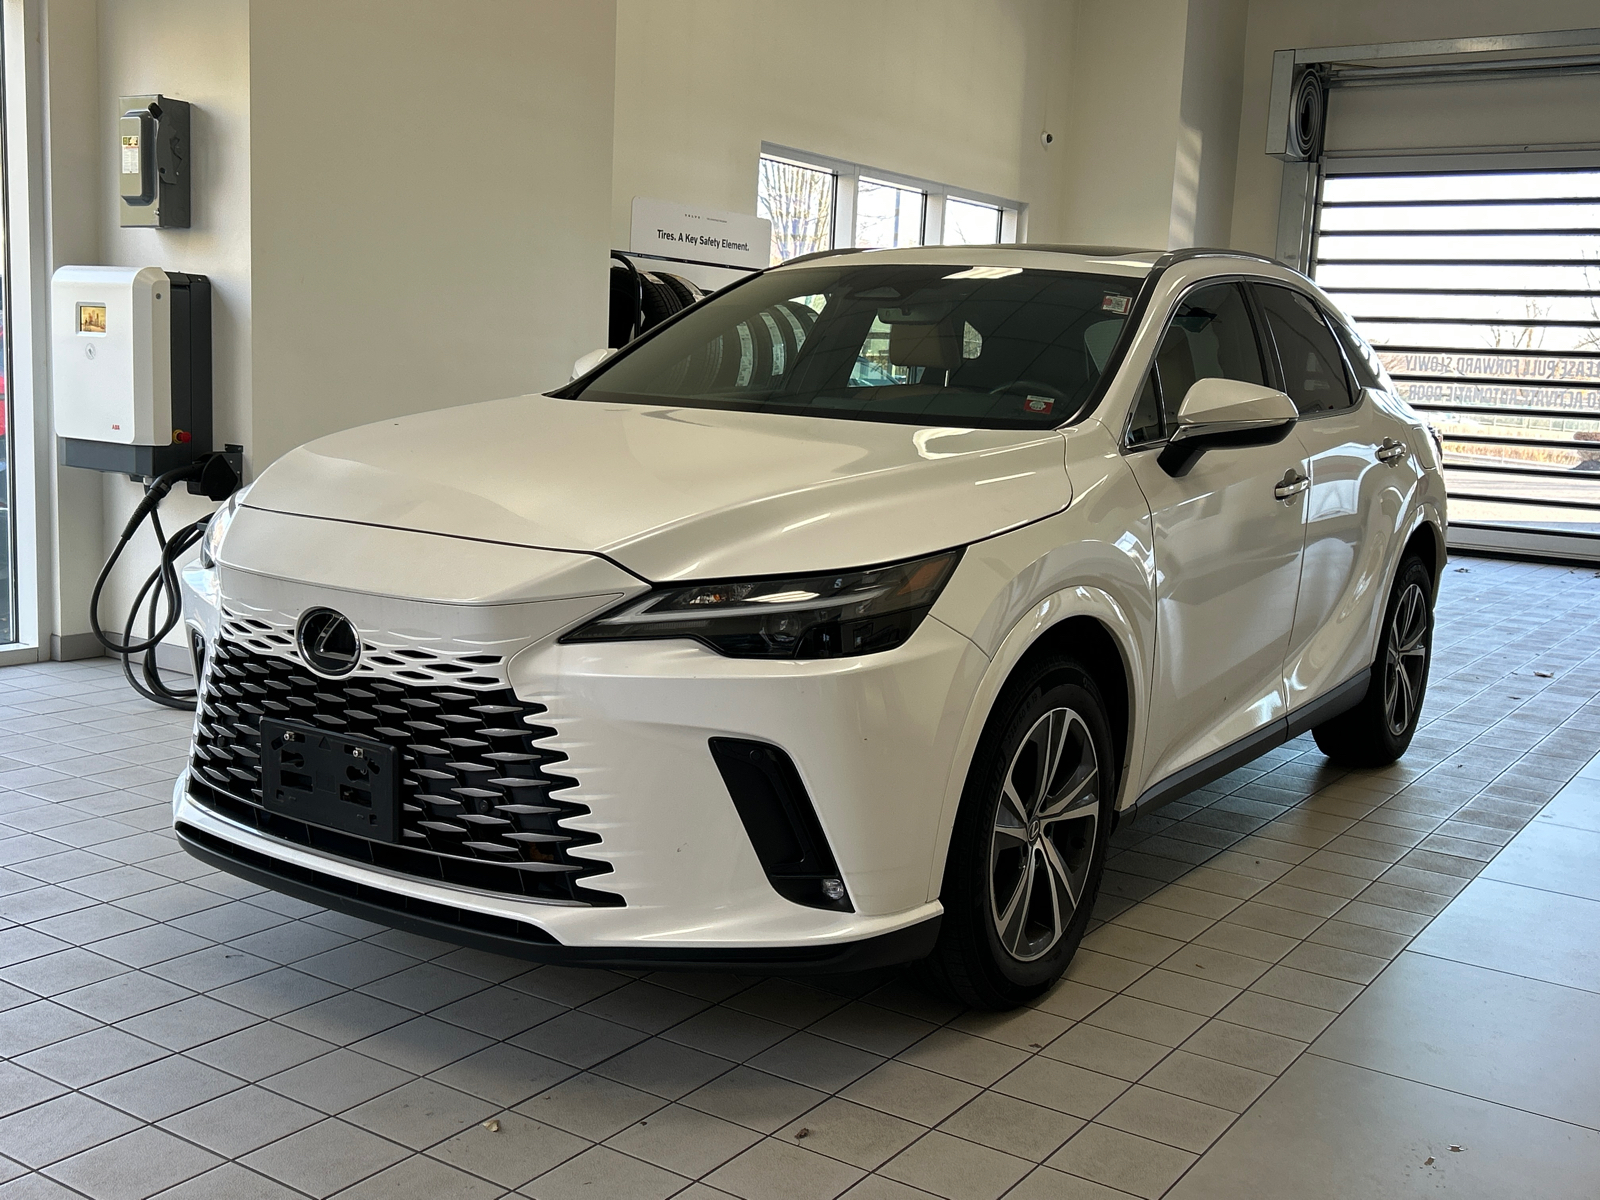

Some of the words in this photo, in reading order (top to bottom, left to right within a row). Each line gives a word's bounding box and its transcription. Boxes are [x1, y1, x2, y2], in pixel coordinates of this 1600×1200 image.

[657, 229, 676, 241] Tires.
[678, 232, 684, 242] A
[685, 233, 698, 246] Key
[699, 235, 721, 249] Safety
[722, 239, 750, 251] Element.
